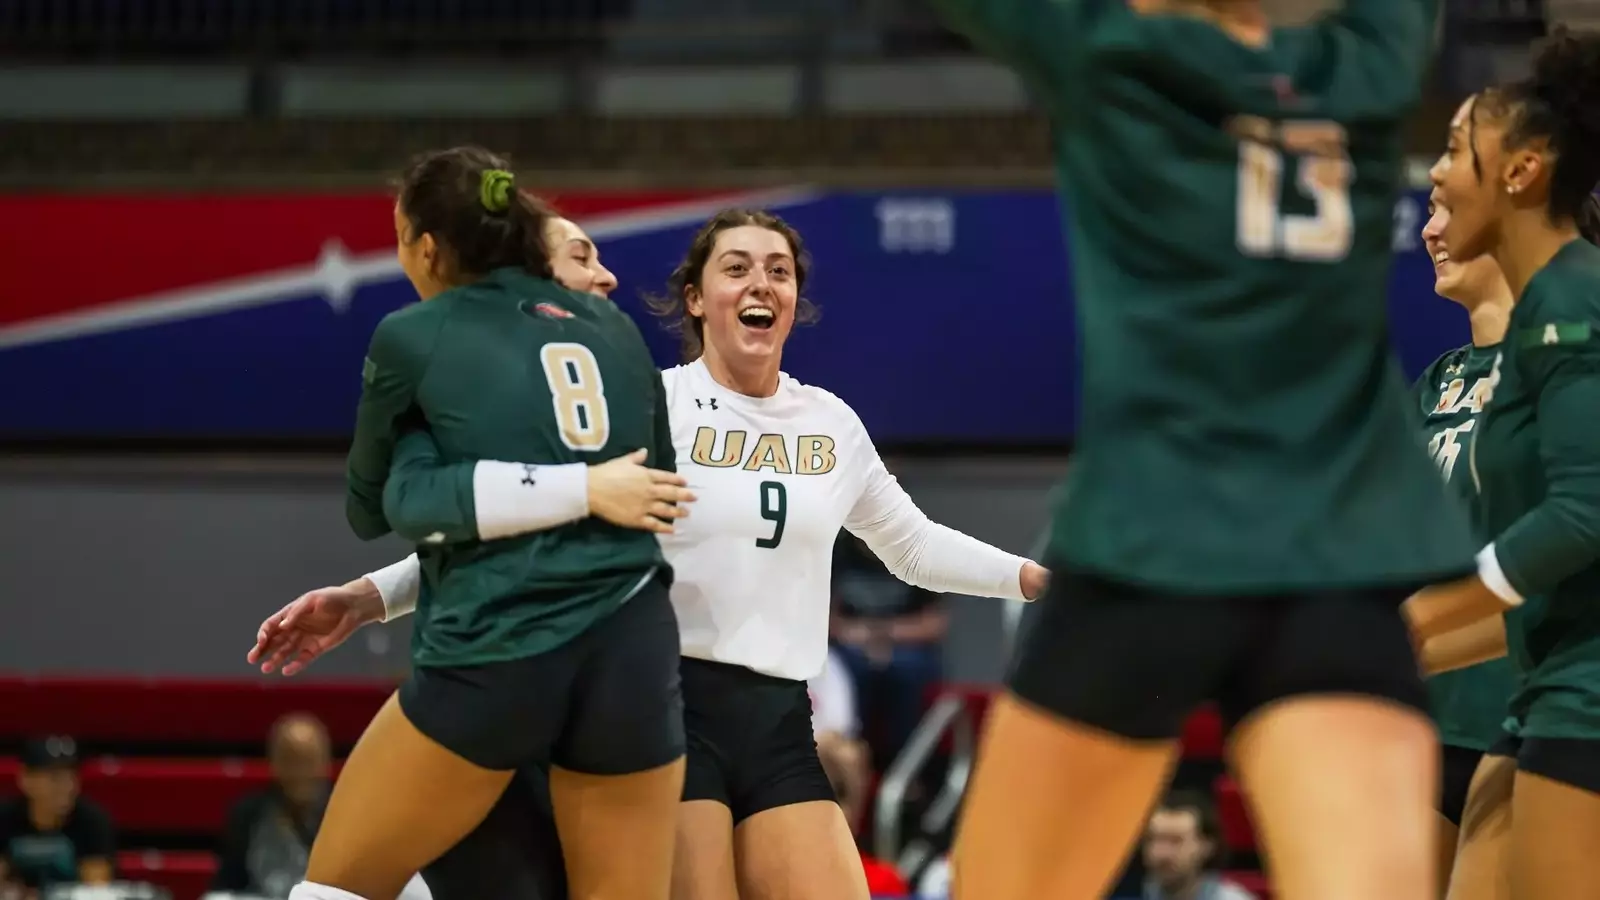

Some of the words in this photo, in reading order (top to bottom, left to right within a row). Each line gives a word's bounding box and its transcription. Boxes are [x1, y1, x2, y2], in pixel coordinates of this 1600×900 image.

[1226, 117, 1355, 260] 13
[541, 343, 609, 451] 8
[690, 426, 836, 475] UAB
[756, 481, 787, 549] 9
